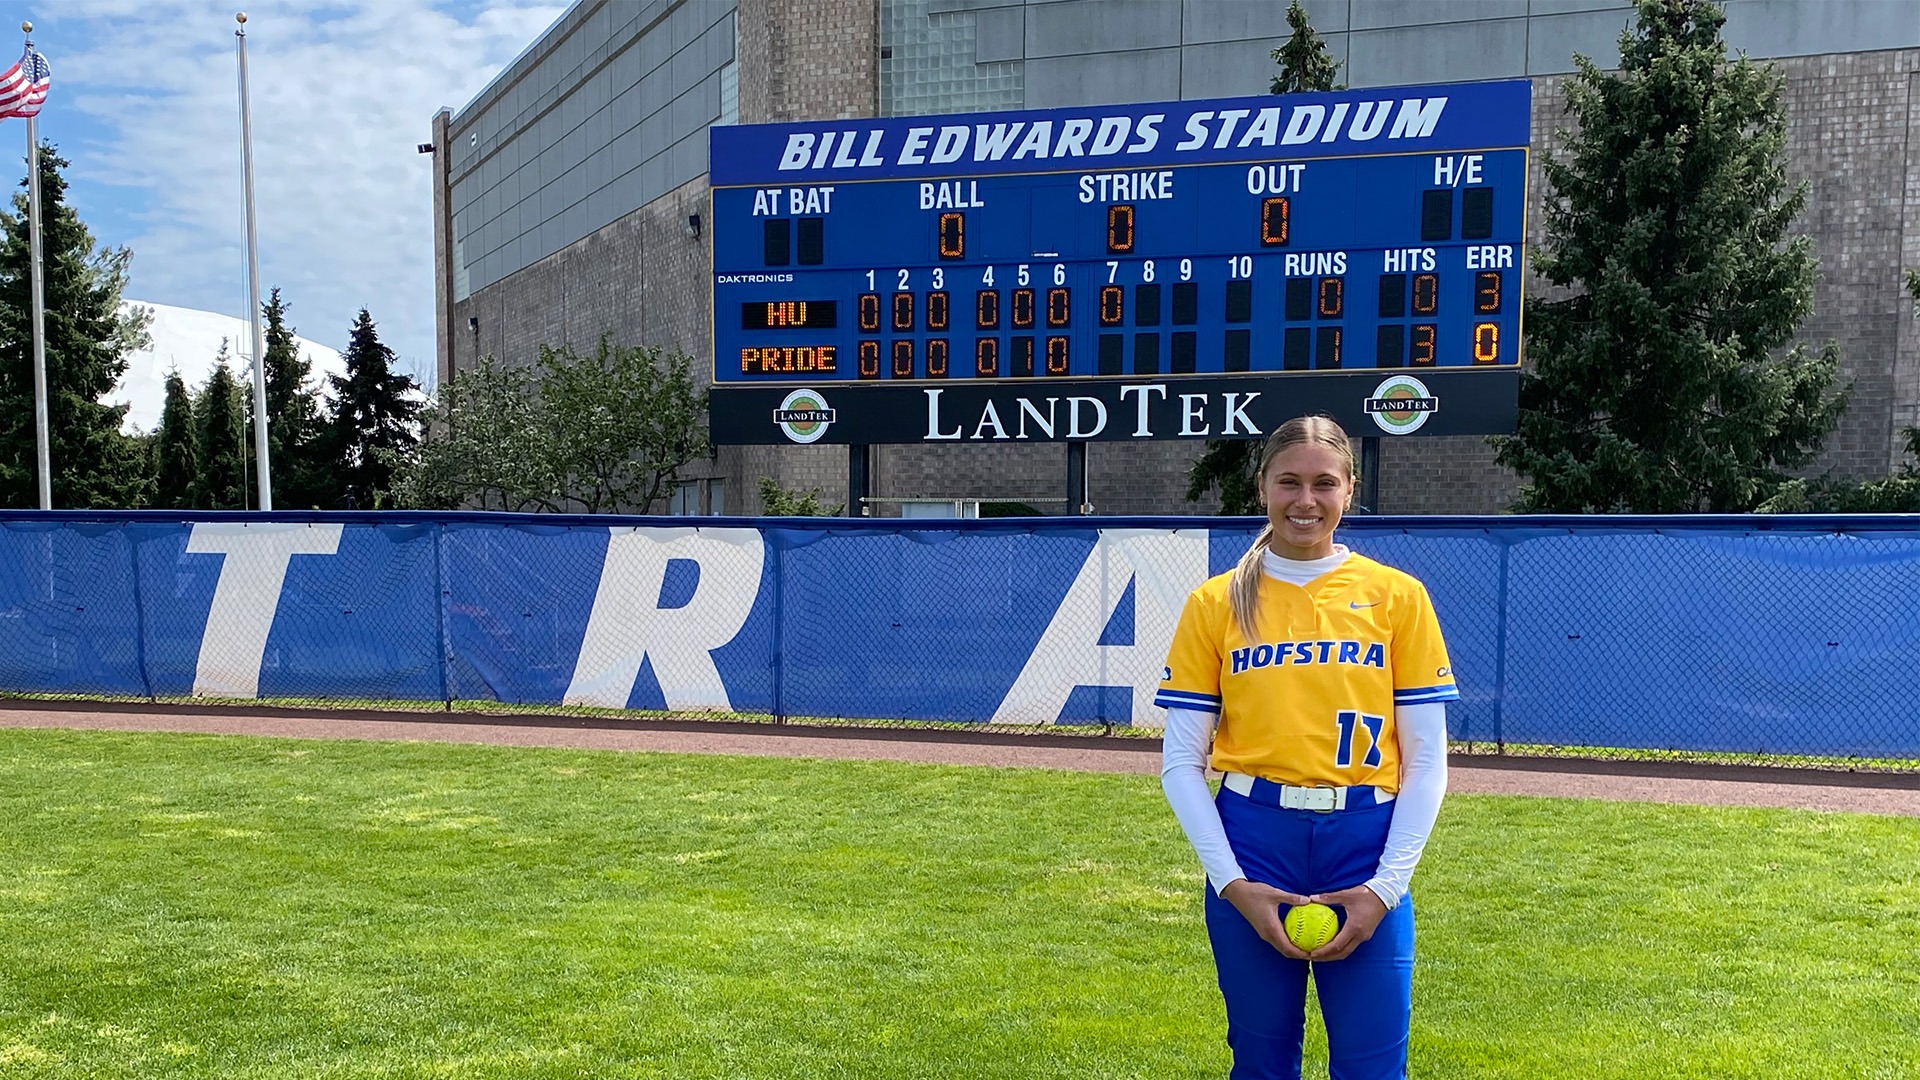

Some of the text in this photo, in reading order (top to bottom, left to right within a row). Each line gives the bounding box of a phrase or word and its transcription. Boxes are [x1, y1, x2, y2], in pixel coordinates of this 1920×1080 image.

[778, 97, 1448, 171] BILL EDWARDS STADIUM
[1079, 171, 1174, 203] STRIKE
[1247, 164, 1306, 195] OUT
[1434, 155, 1484, 188] H/E
[753, 187, 835, 216] AT BAT
[920, 181, 984, 209] BALL
[940, 212, 964, 257] 0
[1108, 205, 1134, 251] 0
[1263, 197, 1288, 243] 0
[717, 273, 794, 284] DAKTRONICS
[866, 245, 1513, 291] 1 2 3 4 5 6 7 8 9 10 RUNS HITS ERR
[767, 273, 1499, 329] HU 0 0 0 0 0 0 0 0 0 3
[741, 346, 836, 371] PRIDE
[860, 341, 878, 375] 0
[895, 341, 912, 375] 0
[928, 340, 946, 375] 0
[979, 339, 996, 373] 0
[1049, 337, 1067, 372] 0
[1416, 325, 1434, 362] 3
[1475, 323, 1499, 361] 0
[1230, 640, 1385, 675] HOFSTRA
